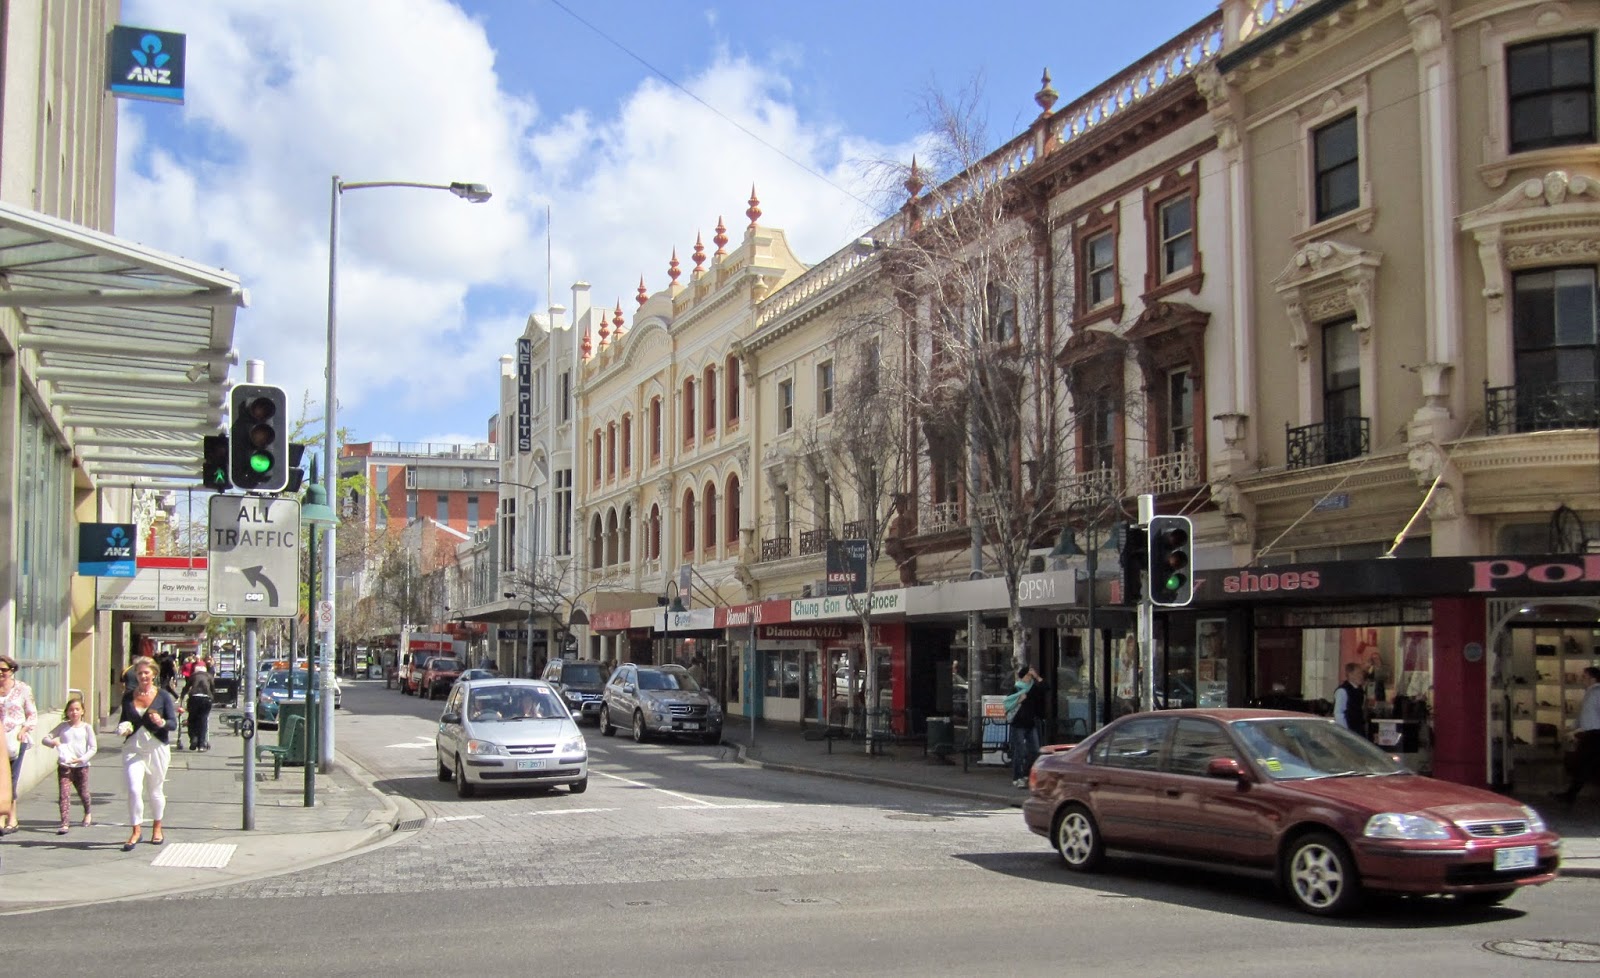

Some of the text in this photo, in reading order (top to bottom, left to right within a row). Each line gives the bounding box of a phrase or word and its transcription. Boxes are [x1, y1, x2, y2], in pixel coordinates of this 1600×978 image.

[127, 67, 171, 85] ANZ
[519, 342, 530, 387] NEIL
[236, 505, 274, 523] ALL
[214, 528, 295, 548] TRAFFIC
[103, 547, 130, 556] ANZ
[829, 573, 857, 582] LEASE
[1223, 570, 1320, 593] shoes
[1018, 579, 1056, 601] OPSM
[794, 600, 819, 617] Chung
[823, 597, 840, 614] Gon
[870, 593, 898, 609] Grocer
[149, 624, 185, 633] MOJO
[766, 626, 843, 637] Diamond NAILS
